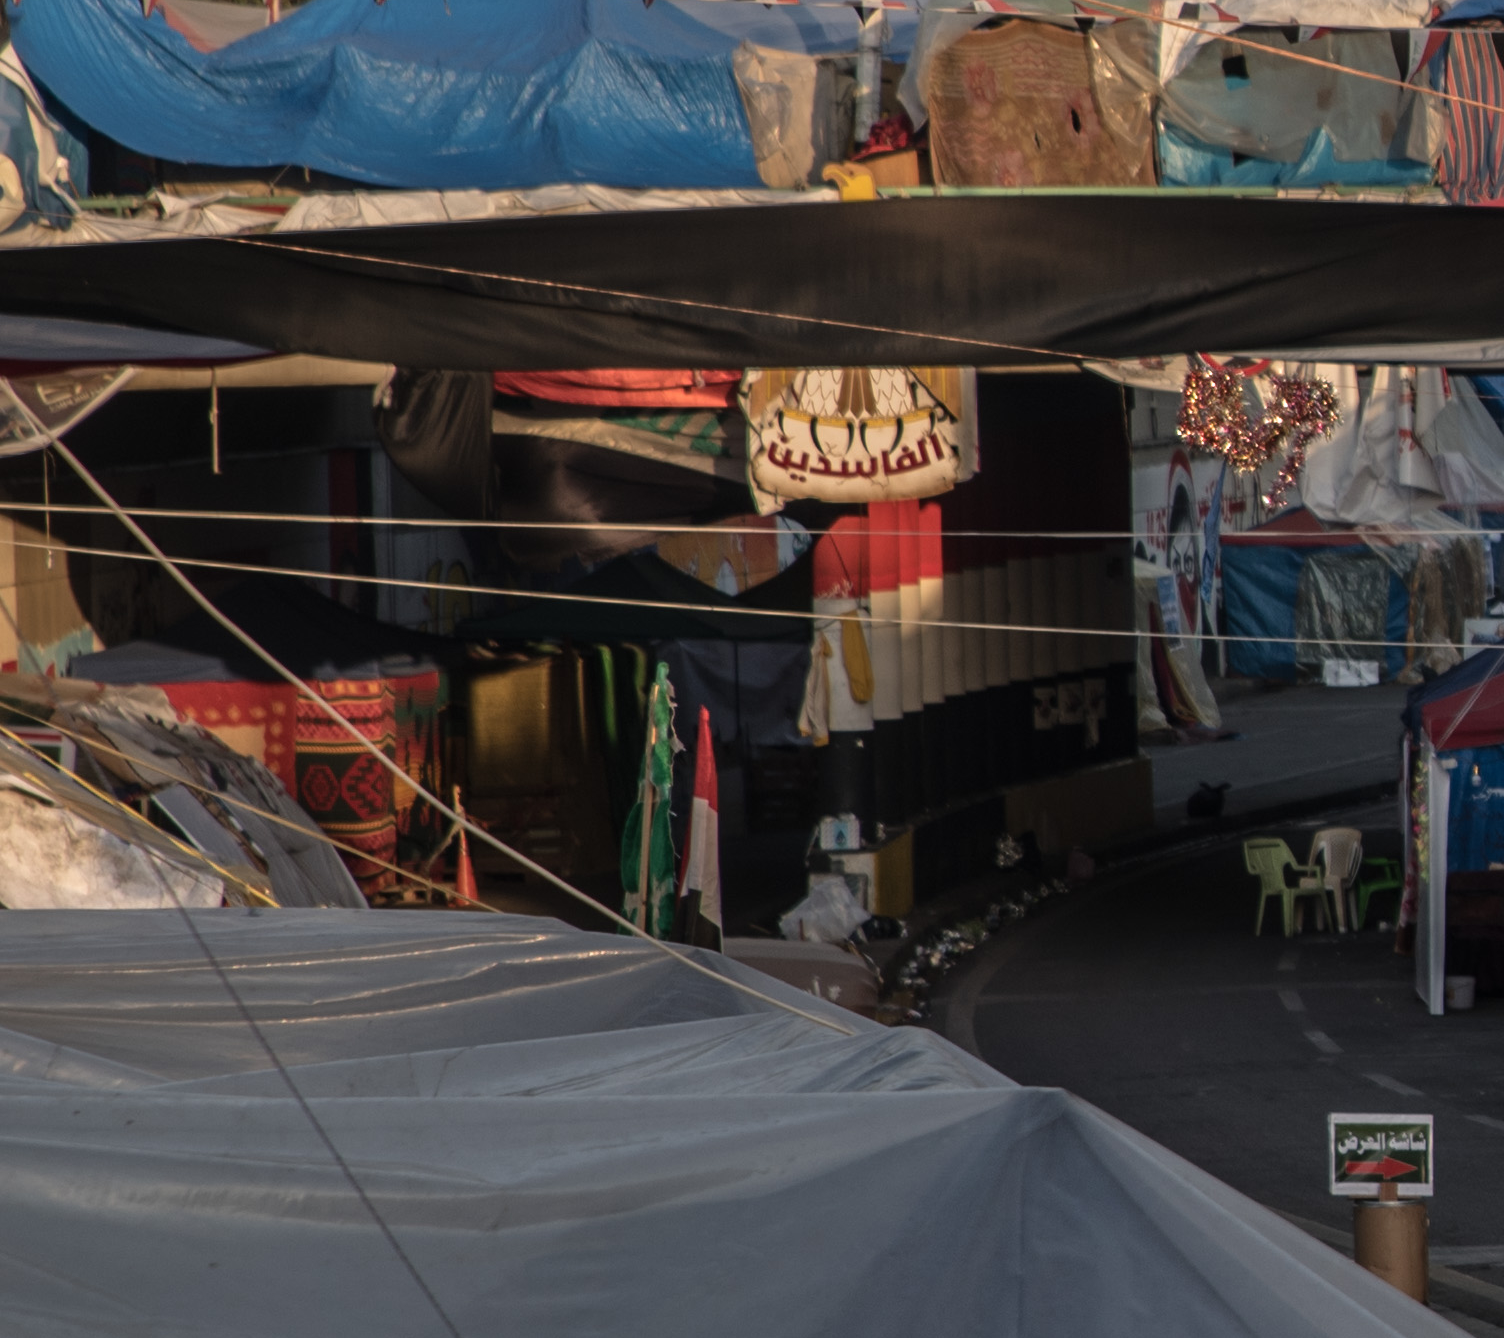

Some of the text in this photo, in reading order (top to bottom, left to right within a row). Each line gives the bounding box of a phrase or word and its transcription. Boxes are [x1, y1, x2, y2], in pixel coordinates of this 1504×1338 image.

[766, 429, 951, 483] الفاسدين
[1337, 1130, 1427, 1155] شاشة العرض
